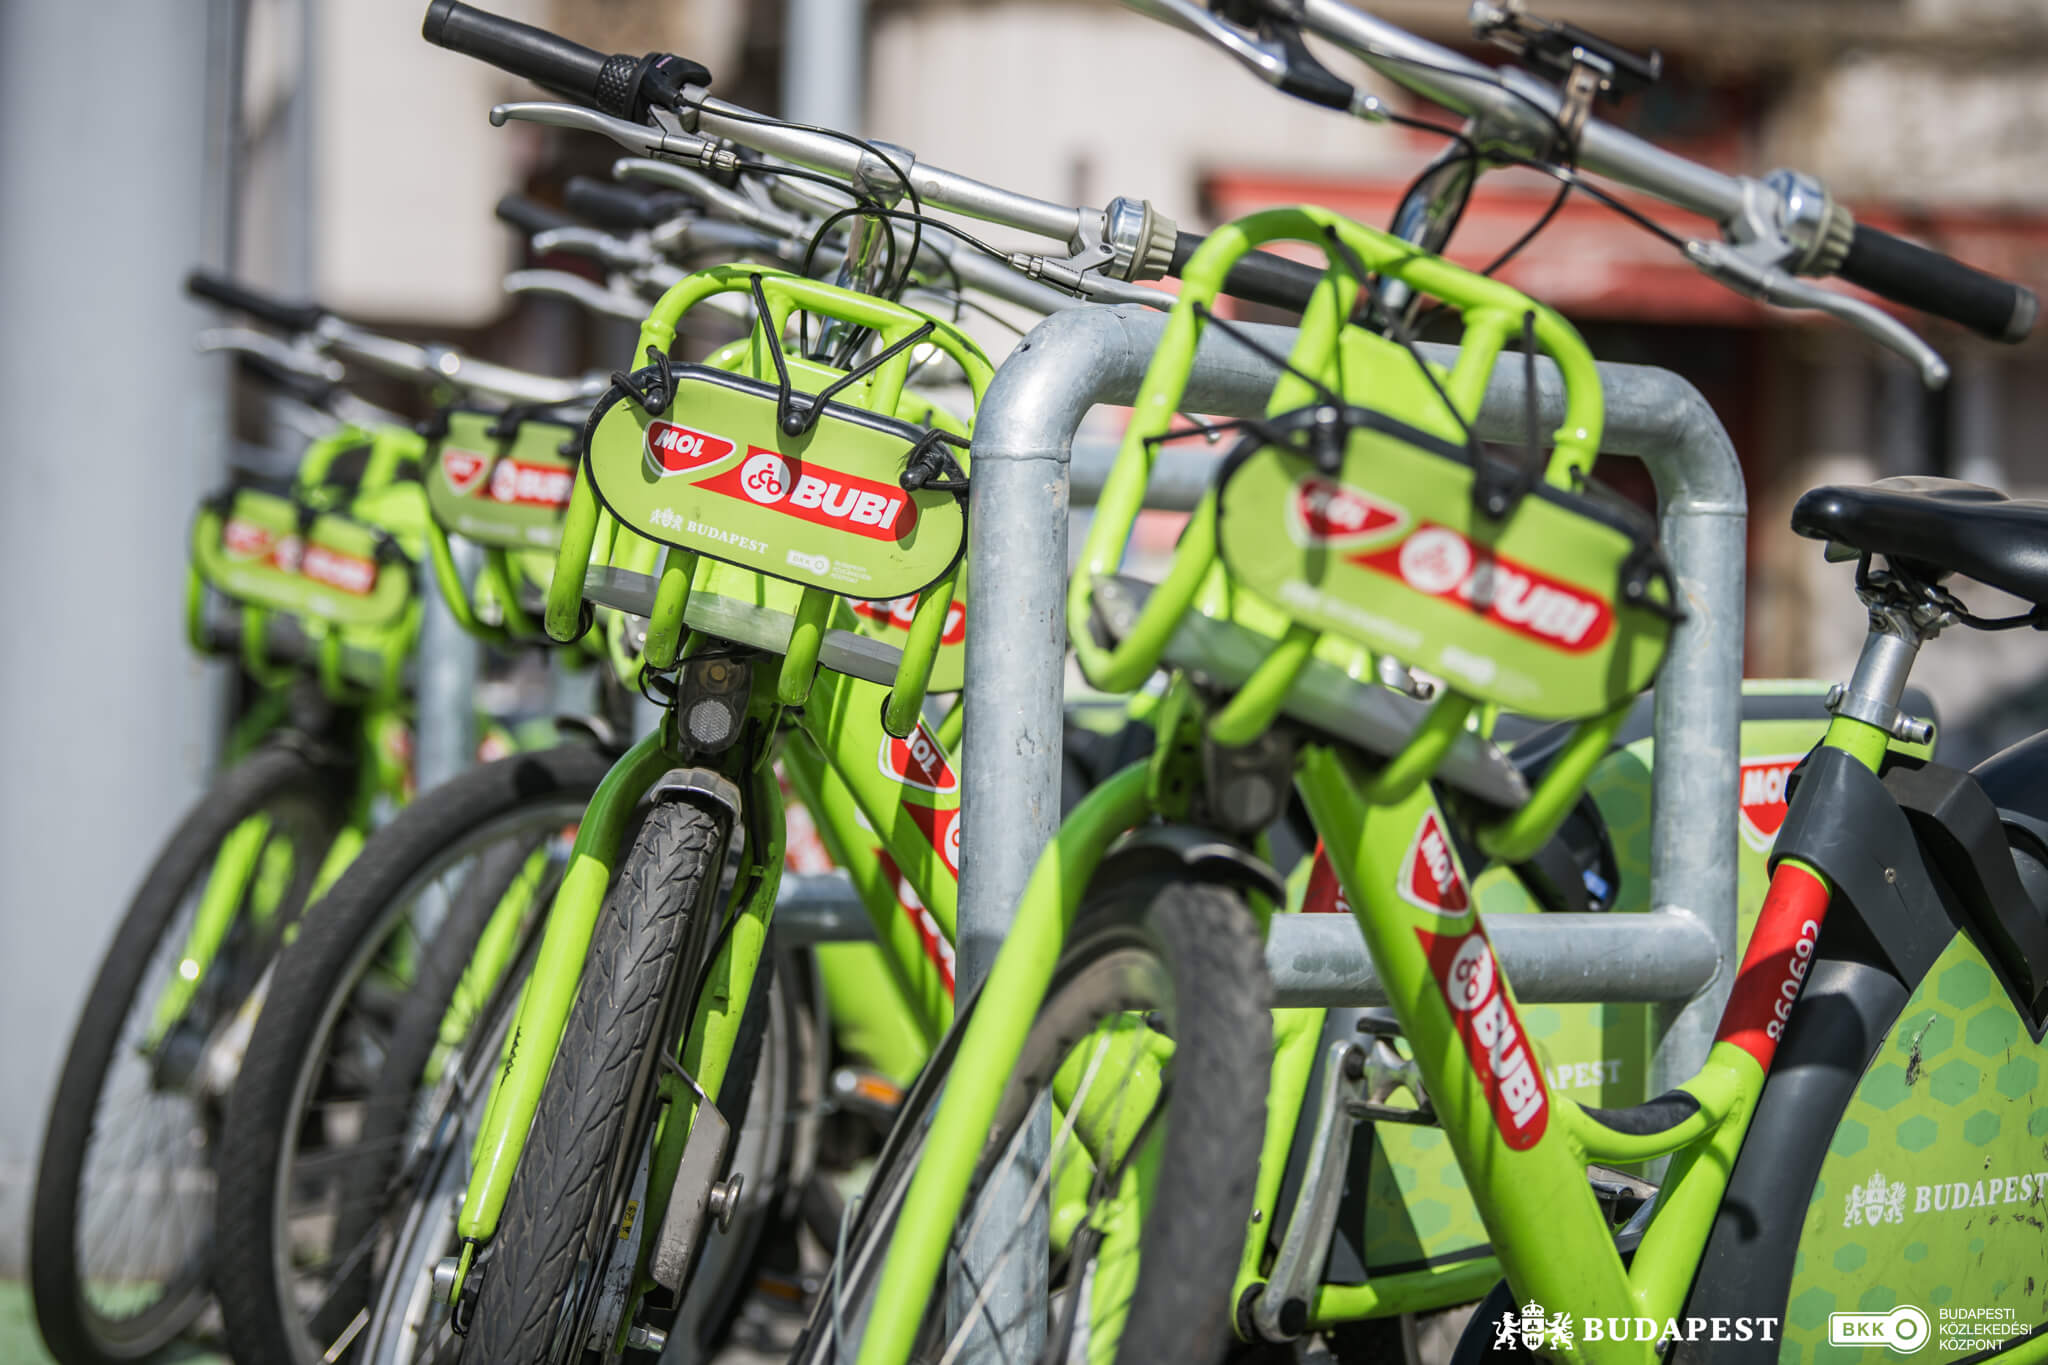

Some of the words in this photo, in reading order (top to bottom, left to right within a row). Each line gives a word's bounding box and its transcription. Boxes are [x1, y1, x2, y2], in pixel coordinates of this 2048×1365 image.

[654, 429, 704, 458] MOL
[789, 474, 902, 530] BUBI
[687, 520, 769, 554] BUDAPEST
[1421, 830, 1453, 895] MOL
[1766, 919, 1819, 1042] 860692
[1472, 993, 1545, 1129] BUBI
[1913, 1172, 2048, 1213] BUDAPEST
